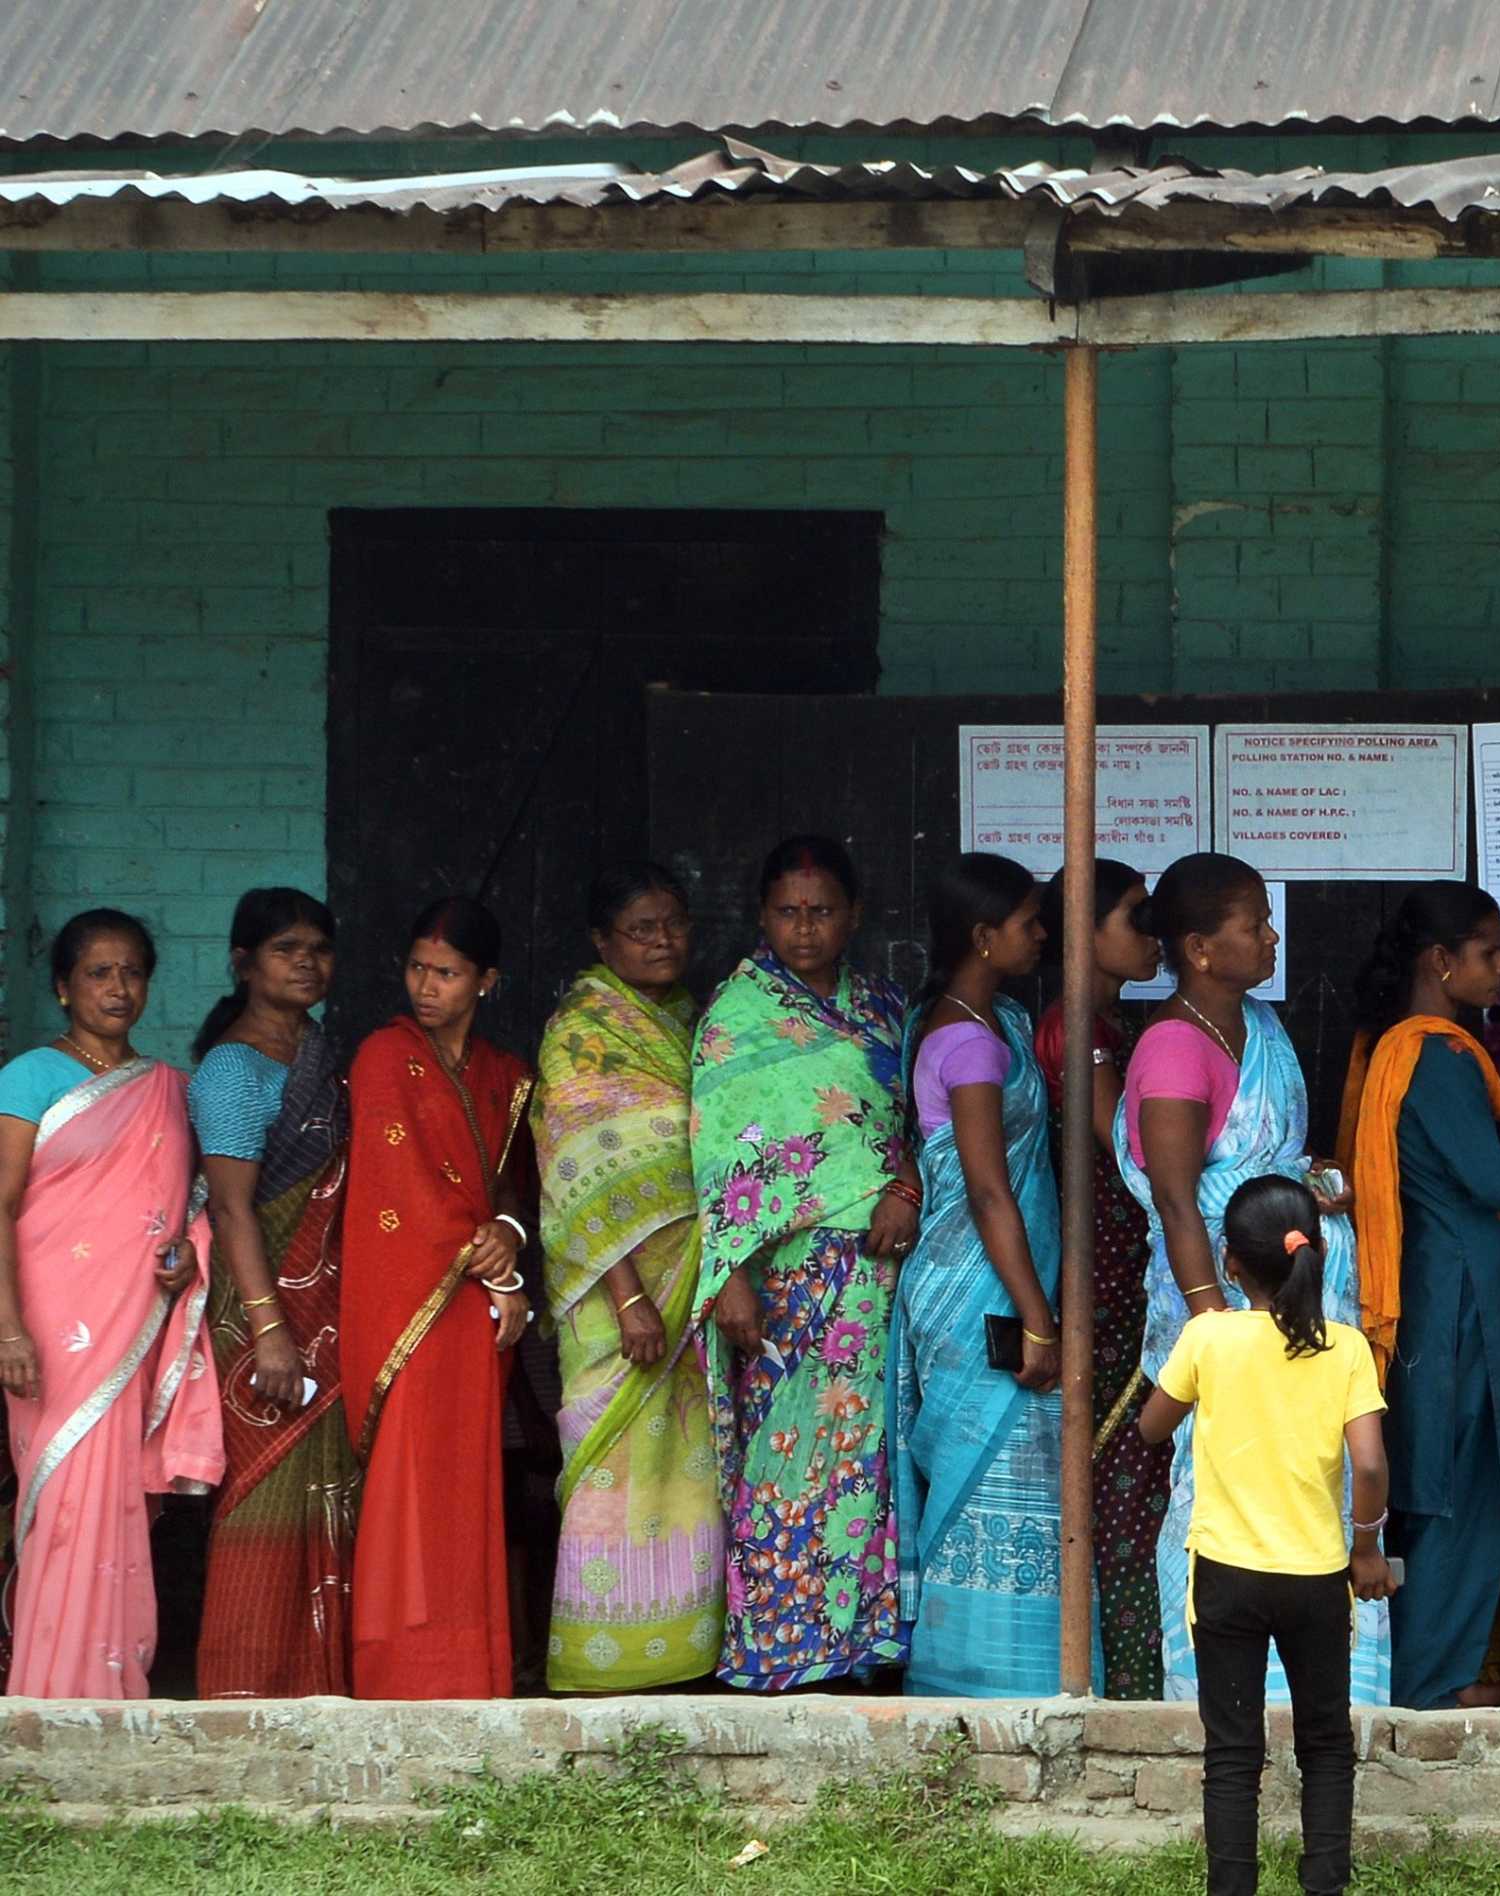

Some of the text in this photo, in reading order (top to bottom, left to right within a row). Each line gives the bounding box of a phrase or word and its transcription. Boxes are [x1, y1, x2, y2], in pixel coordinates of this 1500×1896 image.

[1245, 737, 1438, 747] NOTICE SPECIFYING POLLING AREA
[977, 740, 1001, 754] ভোট
[1232, 753, 1278, 762] POLLING
[1281, 753, 1324, 762] STATION
[1328, 753, 1345, 762] NO.
[1359, 753, 1388, 762] NAME
[977, 759, 1000, 771] ভোট
[1232, 788, 1251, 797] NO.
[1266, 788, 1297, 796] NAME
[1301, 788, 1315, 796] OF
[1319, 788, 1340, 797] LAC
[1232, 808, 1251, 817] NO.
[1267, 808, 1297, 817] NAME
[1301, 808, 1315, 817] OF
[1319, 808, 1349, 817] H.P.C.
[978, 830, 1002, 844] ভোট
[1232, 832, 1286, 841] VILLAGES
[1289, 832, 1341, 840] COVERED
